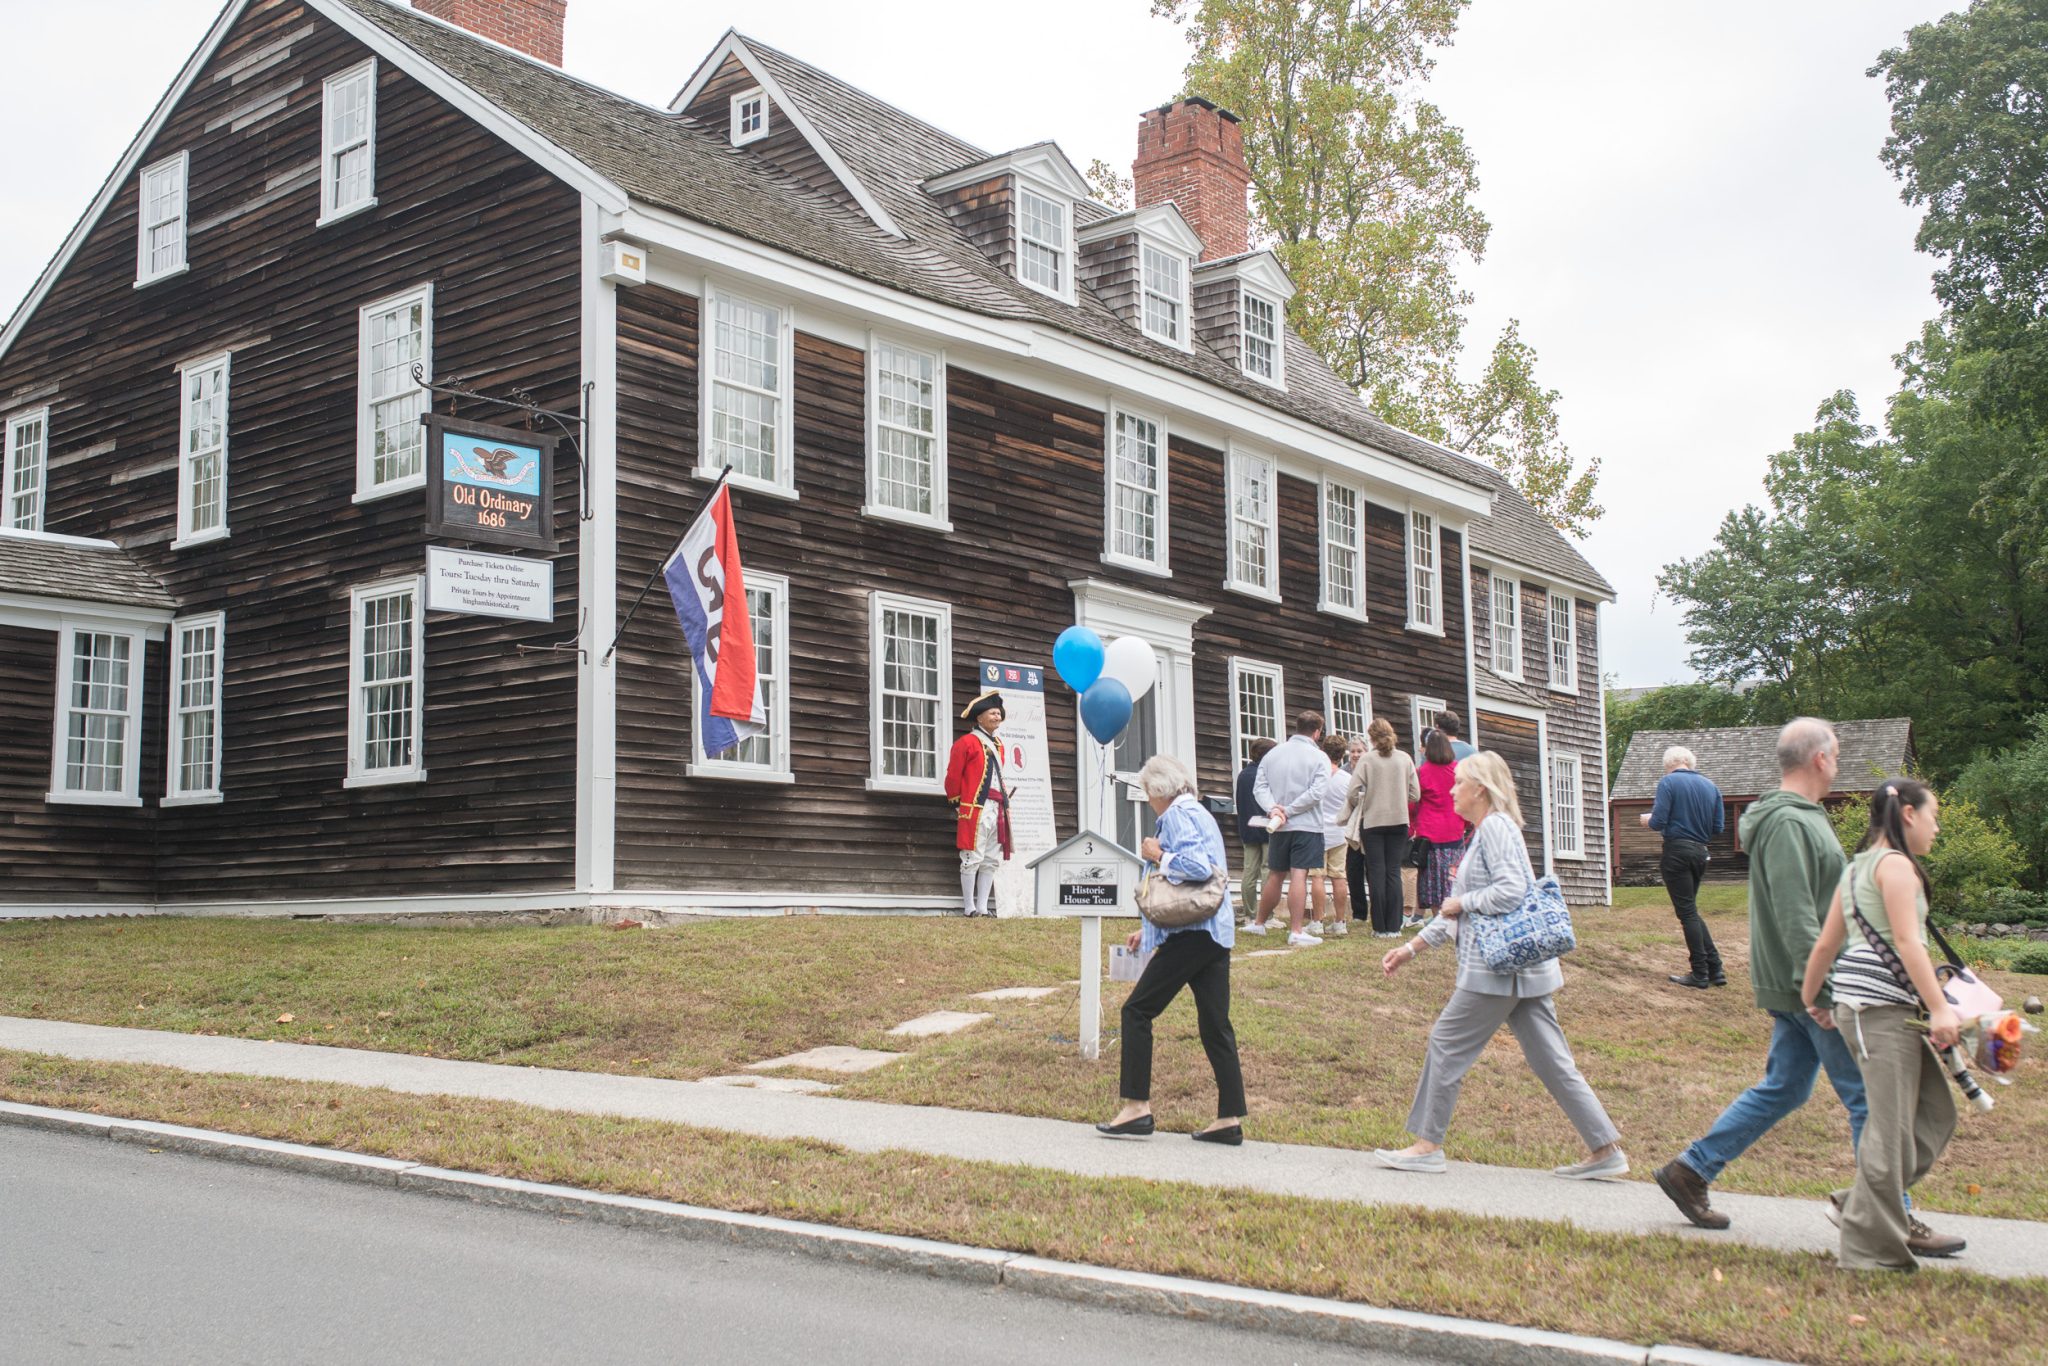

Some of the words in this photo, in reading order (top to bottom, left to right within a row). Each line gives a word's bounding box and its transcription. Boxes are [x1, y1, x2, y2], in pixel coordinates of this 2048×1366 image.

[454, 485, 475, 505] Old
[480, 489, 532, 519] Ordinary
[478, 509, 506, 527] 1686
[458, 558, 483, 568] Purchase
[485, 561, 504, 570] Tickets
[505, 563, 524, 572] Online
[440, 568, 462, 578] Tours:
[464, 571, 491, 583] Tuesday
[494, 576, 509, 585] thru
[511, 577, 540, 588] Saturday
[451, 586, 471, 595] Private
[472, 589, 487, 597] Tours
[488, 590, 495, 598] by
[497, 592, 531, 601] Appointment
[1084, 841, 1093, 855] 3
[1072, 885, 1105, 895] Historic
[1064, 895, 1090, 904] House
[1092, 895, 1113, 904] Tour
